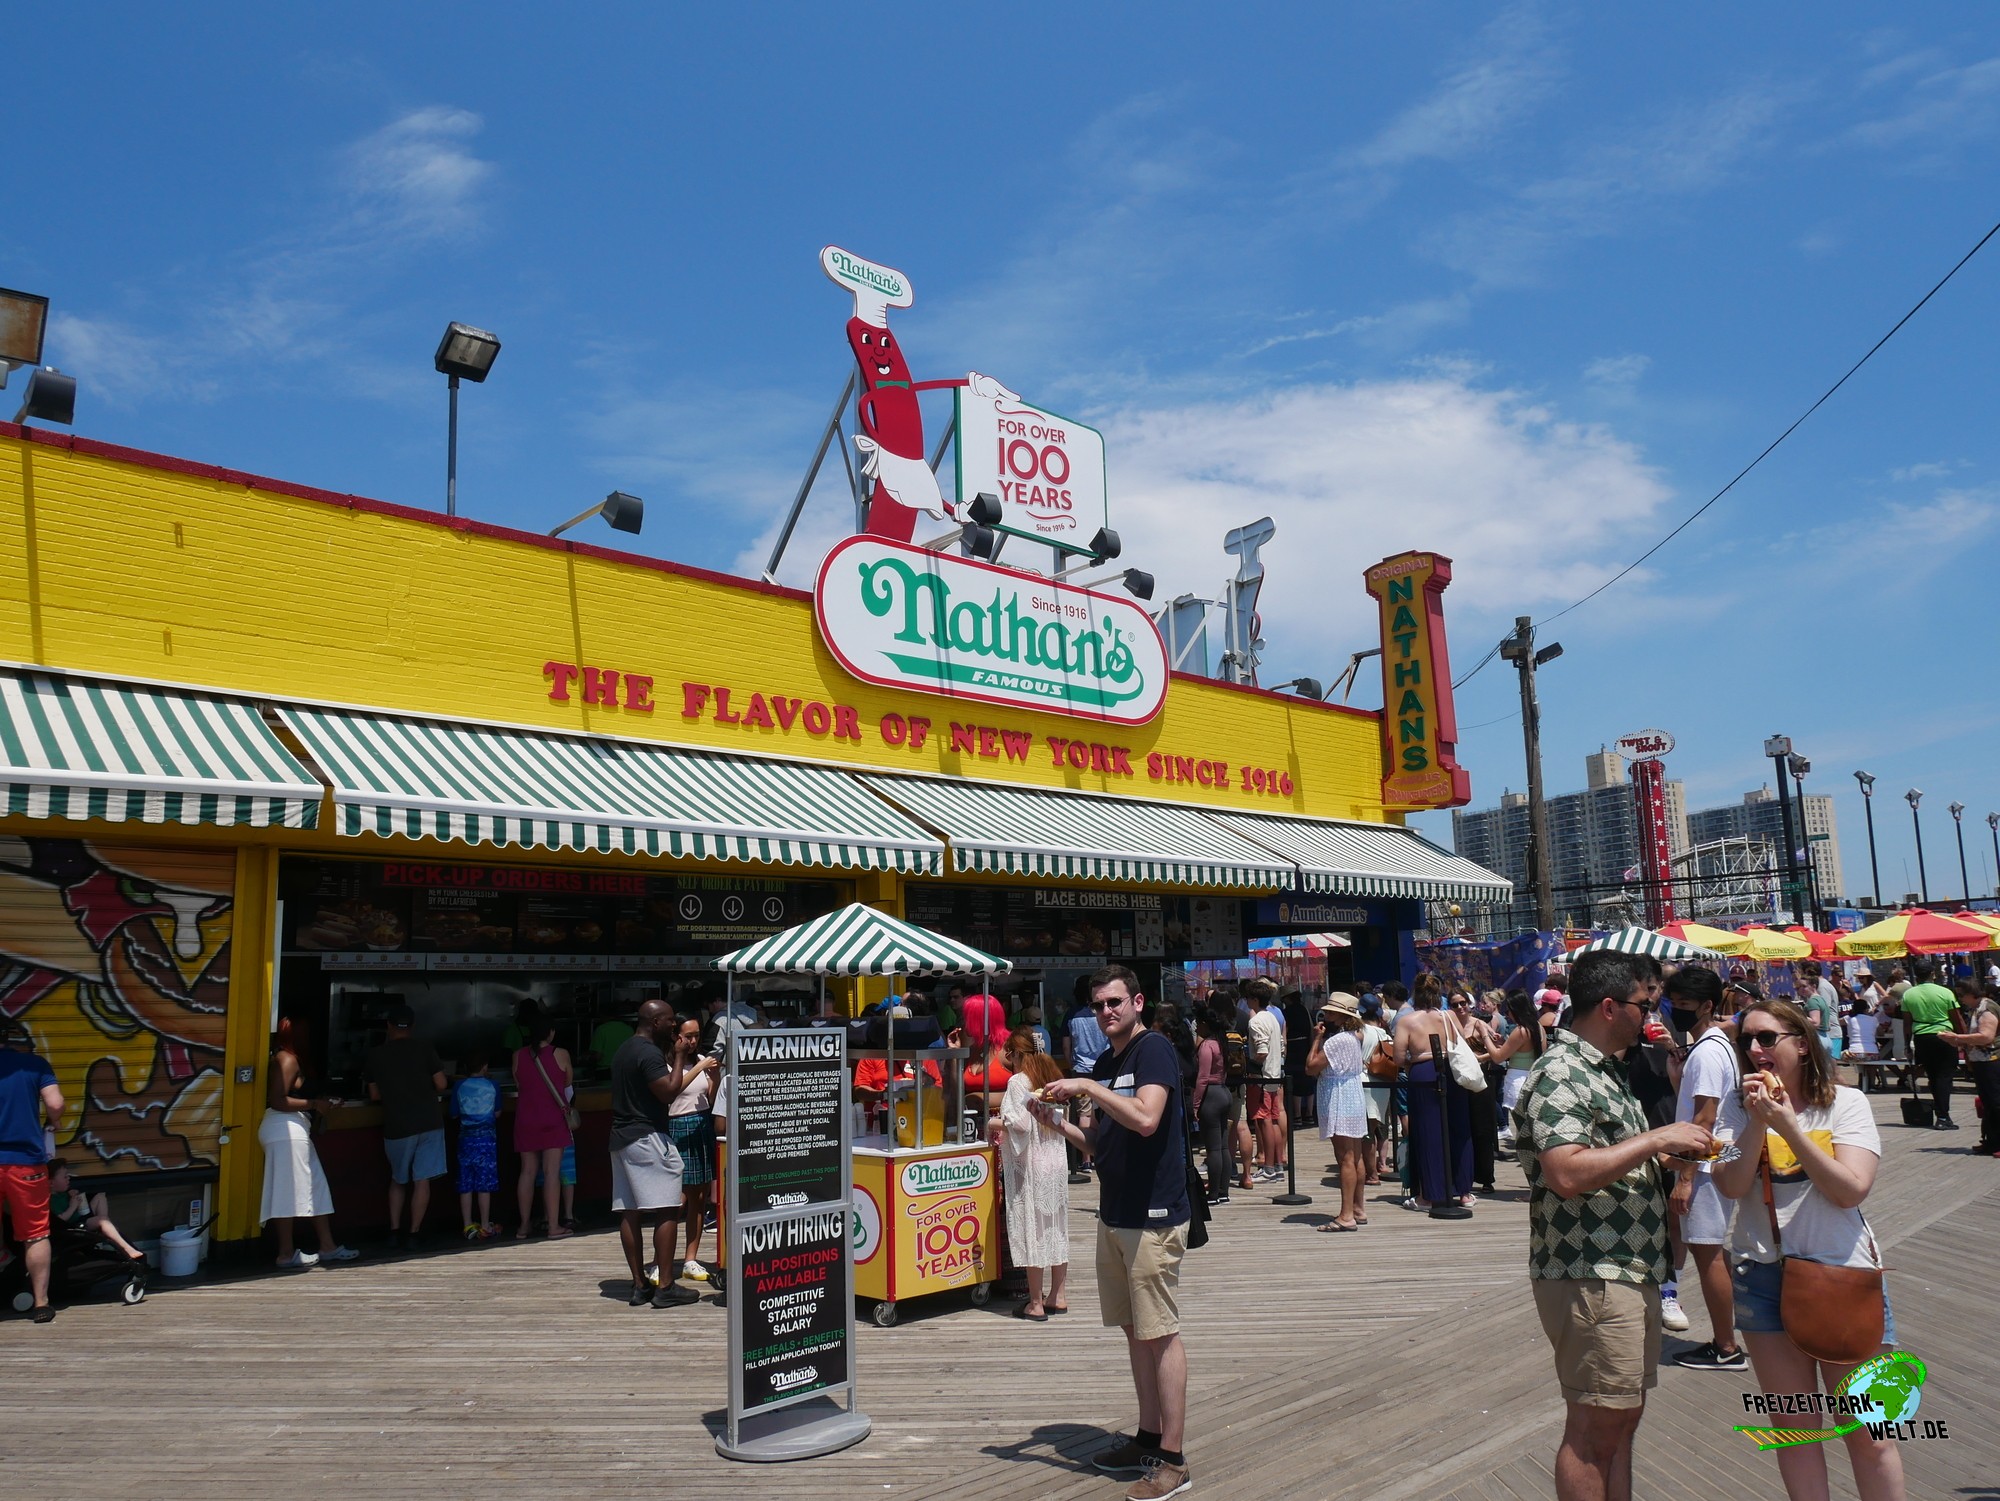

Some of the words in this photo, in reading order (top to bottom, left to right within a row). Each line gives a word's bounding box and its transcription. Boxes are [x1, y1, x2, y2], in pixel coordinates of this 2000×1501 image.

[831, 252, 902, 293] Nathan's
[998, 418, 1026, 436] FOR
[1031, 424, 1066, 445] OVER
[998, 437, 1071, 486] 100
[998, 479, 1073, 512] YEARS
[1036, 523, 1051, 532] Since
[1052, 522, 1065, 532] 1916
[1372, 557, 1429, 580] ORIGINAL
[1032, 596, 1061, 615] Since
[1064, 604, 1087, 620] 1916
[858, 557, 1137, 684] Nathan's
[972, 670, 1063, 696] FAMOUS
[1388, 575, 1429, 772] NATHANS
[543, 660, 655, 712] THE
[681, 682, 862, 741] FLAVOR
[880, 712, 931, 749] OF
[950, 721, 1032, 762] NEW
[1047, 736, 1134, 776] YORK
[1148, 752, 1231, 788] SINCE
[1240, 766, 1294, 797] 1916
[1620, 736, 1650, 748] TWIST
[1654, 735, 1662, 744] &
[383, 863, 485, 886] PICK-UP
[491, 868, 583, 891] ORDERS
[589, 873, 646, 894] HERE
[676, 875, 700, 890] SELF
[702, 876, 733, 891] ORDER
[743, 878, 760, 892] PAY
[763, 878, 786, 893] HERE
[1035, 889, 1076, 906] PLACE
[1079, 892, 1128, 909] ORDERS
[1131, 894, 1161, 909] HERE
[1838, 1003, 1854, 1012] FDN
[738, 1035, 841, 1061] WARNING!
[745, 1073, 779, 1082] CONSUMPTION
[787, 1071, 813, 1079] ALCOHOLIC
[772, 1093, 806, 1101] RESTAURANT'S
[806, 1091, 831, 1099] PROPERTY.
[783, 1102, 810, 1110] ALCOHOLIC
[810, 1100, 838, 1108] BEVERAGES
[740, 1113, 754, 1121] FOOD
[754, 1112, 767, 1120] MUST
[768, 1111, 797, 1119] ACCOMPANY
[809, 1107, 835, 1115] PURCHASE.
[745, 1122, 767, 1130] PATRONS
[766, 1127, 794, 1135] DISTANCING
[738, 1147, 767, 1156] CONTAINERS
[775, 1144, 797, 1152] ALCOHOL
[797, 1142, 812, 1150] BEING
[812, 1140, 839, 1148] CONSUMED
[781, 1136, 802, 1144] IMPOSED
[787, 1150, 810, 1158] PREMISES
[774, 1170, 800, 1179] CONSUMED
[824, 1165, 839, 1173] POINT
[908, 1159, 979, 1186] Nathan's
[767, 1190, 809, 1206] Nathan's
[916, 1212, 942, 1230] FOR
[945, 1201, 977, 1220] OVER
[742, 1221, 783, 1255] NOW
[787, 1211, 843, 1247] HIRING
[916, 1215, 980, 1261] 100
[745, 1262, 768, 1278] ALL
[771, 1247, 839, 1273] POSITIONS
[916, 1244, 983, 1279] YEARS
[756, 1267, 826, 1293] AVAILABLE
[759, 1287, 825, 1311] COMPETITIVE
[767, 1302, 817, 1323] STARTING
[773, 1317, 812, 1335] SALARY
[743, 1347, 763, 1361] FREE
[765, 1339, 795, 1356] MEALS
[802, 1329, 845, 1347] BENEFITS
[745, 1362, 757, 1370] FILL
[757, 1357, 770, 1367] OUT
[771, 1355, 780, 1363] AN
[780, 1345, 819, 1361] APPLICATION
[819, 1340, 841, 1351] TODAY!
[770, 1365, 818, 1387] Nathan's
[774, 1390, 794, 1400] FLAVOR
